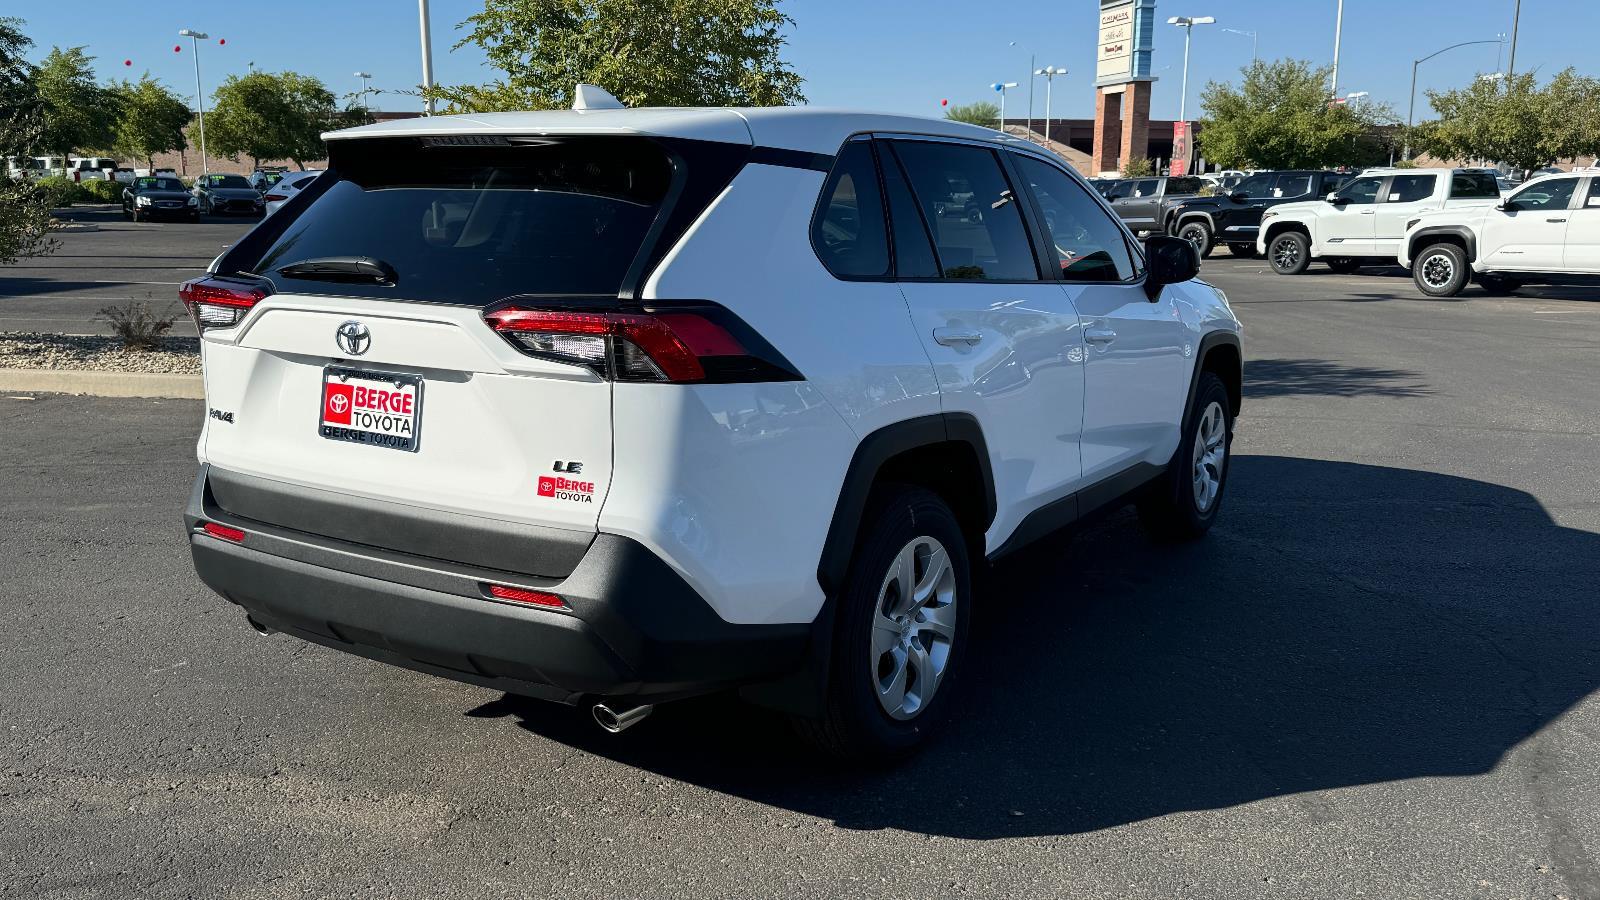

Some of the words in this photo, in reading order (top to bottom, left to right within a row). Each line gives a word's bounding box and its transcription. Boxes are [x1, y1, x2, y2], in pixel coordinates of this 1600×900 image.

[354, 386, 413, 414] BERGE
[354, 412, 411, 434] TOYOTA
[323, 425, 366, 441] BERGE
[370, 433, 409, 448] TOYOTA
[553, 461, 583, 474] LE
[556, 477, 595, 493] BERGE
[556, 491, 592, 503] TOYOTA
